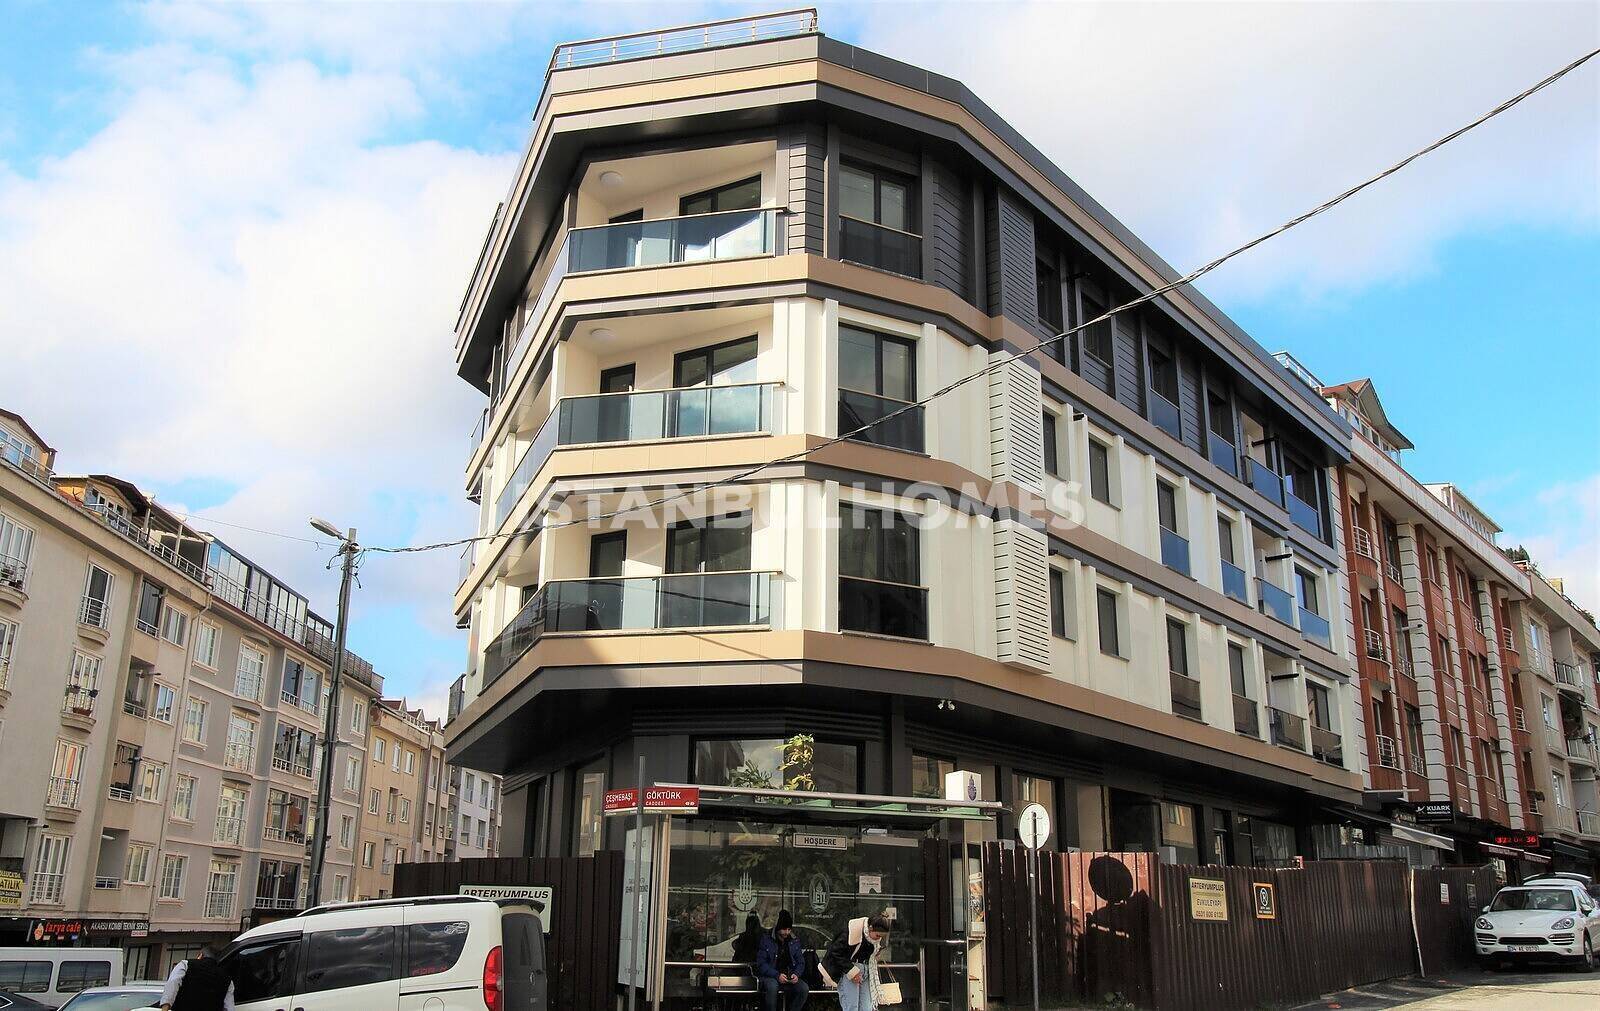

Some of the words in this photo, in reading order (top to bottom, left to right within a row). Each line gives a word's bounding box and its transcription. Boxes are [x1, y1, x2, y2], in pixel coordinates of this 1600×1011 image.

[605, 792, 633, 803] ÇEŞMEBAŞI
[646, 790, 681, 800] GÖKTÜRK
[804, 837, 837, 846] HOŞDERE
[463, 889, 549, 899] ARTERYUMPLUS
